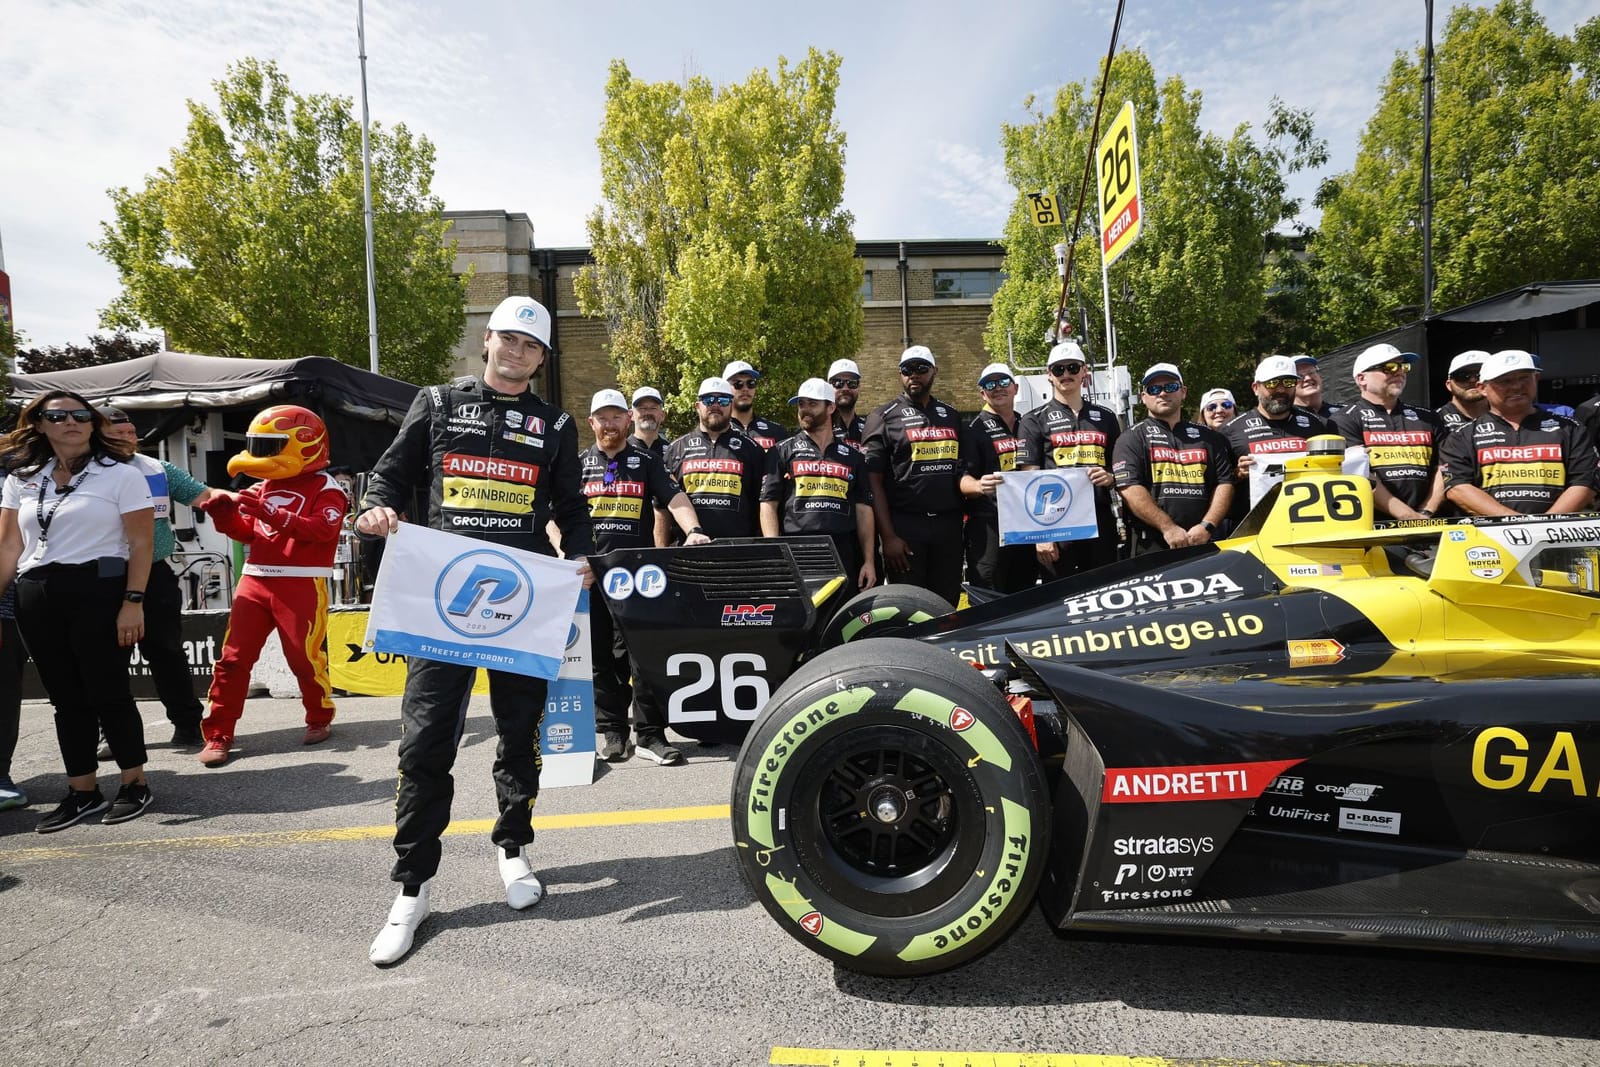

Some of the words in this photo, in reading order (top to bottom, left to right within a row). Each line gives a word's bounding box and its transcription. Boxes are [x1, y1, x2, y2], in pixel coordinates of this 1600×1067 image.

[1102, 125, 1131, 215] 26
[1034, 197, 1055, 225] 26
[1108, 208, 1132, 245] HERTA
[448, 418, 487, 426] HONDA
[911, 429, 955, 439] ANDRETTI
[1055, 433, 1105, 444] ANDRETTI
[1369, 432, 1430, 443] ANDRETTI
[1254, 439, 1307, 453] ANDRET
[1482, 447, 1562, 461] ANDRETTI
[449, 458, 534, 481] ANDRETTI
[685, 460, 741, 472] ANDRETTI
[797, 463, 849, 476] ANDRETTI
[583, 482, 641, 495] ANDRETTI
[1494, 489, 1550, 499] GROUP1001
[461, 487, 529, 506] GAINBRIDGE
[692, 498, 731, 506] GROUP1001
[1284, 480, 1363, 524] 26
[452, 515, 522, 528] GROUP1001
[593, 523, 632, 531] ROUP1001
[1397, 519, 1449, 528] GAINBRIDGE
[1290, 567, 1318, 575] Herta
[1064, 572, 1243, 617] HONDA
[494, 612, 513, 621] NTT
[721, 604, 776, 622] HRC
[420, 644, 460, 657] STREETS
[475, 652, 514, 664] TORONTO
[951, 642, 999, 666] sit
[666, 653, 770, 723] 26
[836, 679, 846, 691] R
[548, 700, 582, 713] 025
[751, 700, 840, 816] Firestone
[1472, 726, 1600, 797] GA
[1112, 770, 1248, 796] ANDRETTI
[1269, 805, 1331, 822] UniFirst
[1362, 814, 1393, 824] BASF
[1113, 834, 1214, 857] stratasys
[1168, 866, 1194, 878] NTT
[933, 834, 1027, 950] Firestone
[1101, 887, 1193, 903] Firestone
